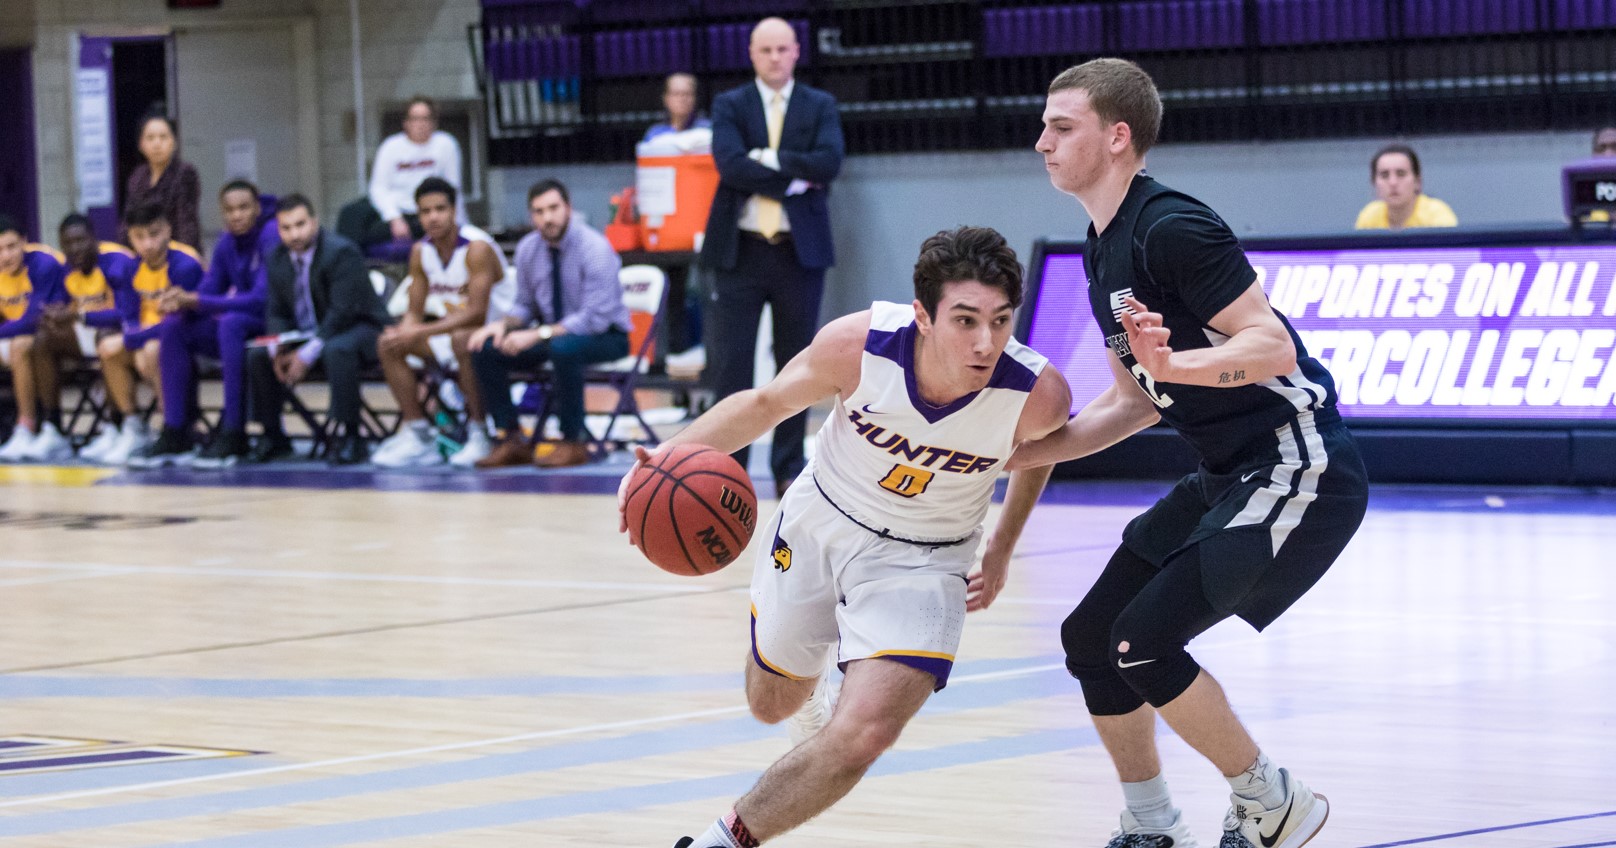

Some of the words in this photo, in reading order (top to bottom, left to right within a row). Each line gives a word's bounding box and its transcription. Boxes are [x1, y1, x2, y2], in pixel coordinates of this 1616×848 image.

[1269, 263, 1455, 318] UPDATES
[1454, 261, 1526, 317] ON
[1518, 260, 1600, 317] ALL
[1127, 363, 1175, 409] 2
[1217, 370, 1246, 384] 危机
[848, 410, 999, 474] HUNTER
[877, 463, 935, 498] 0
